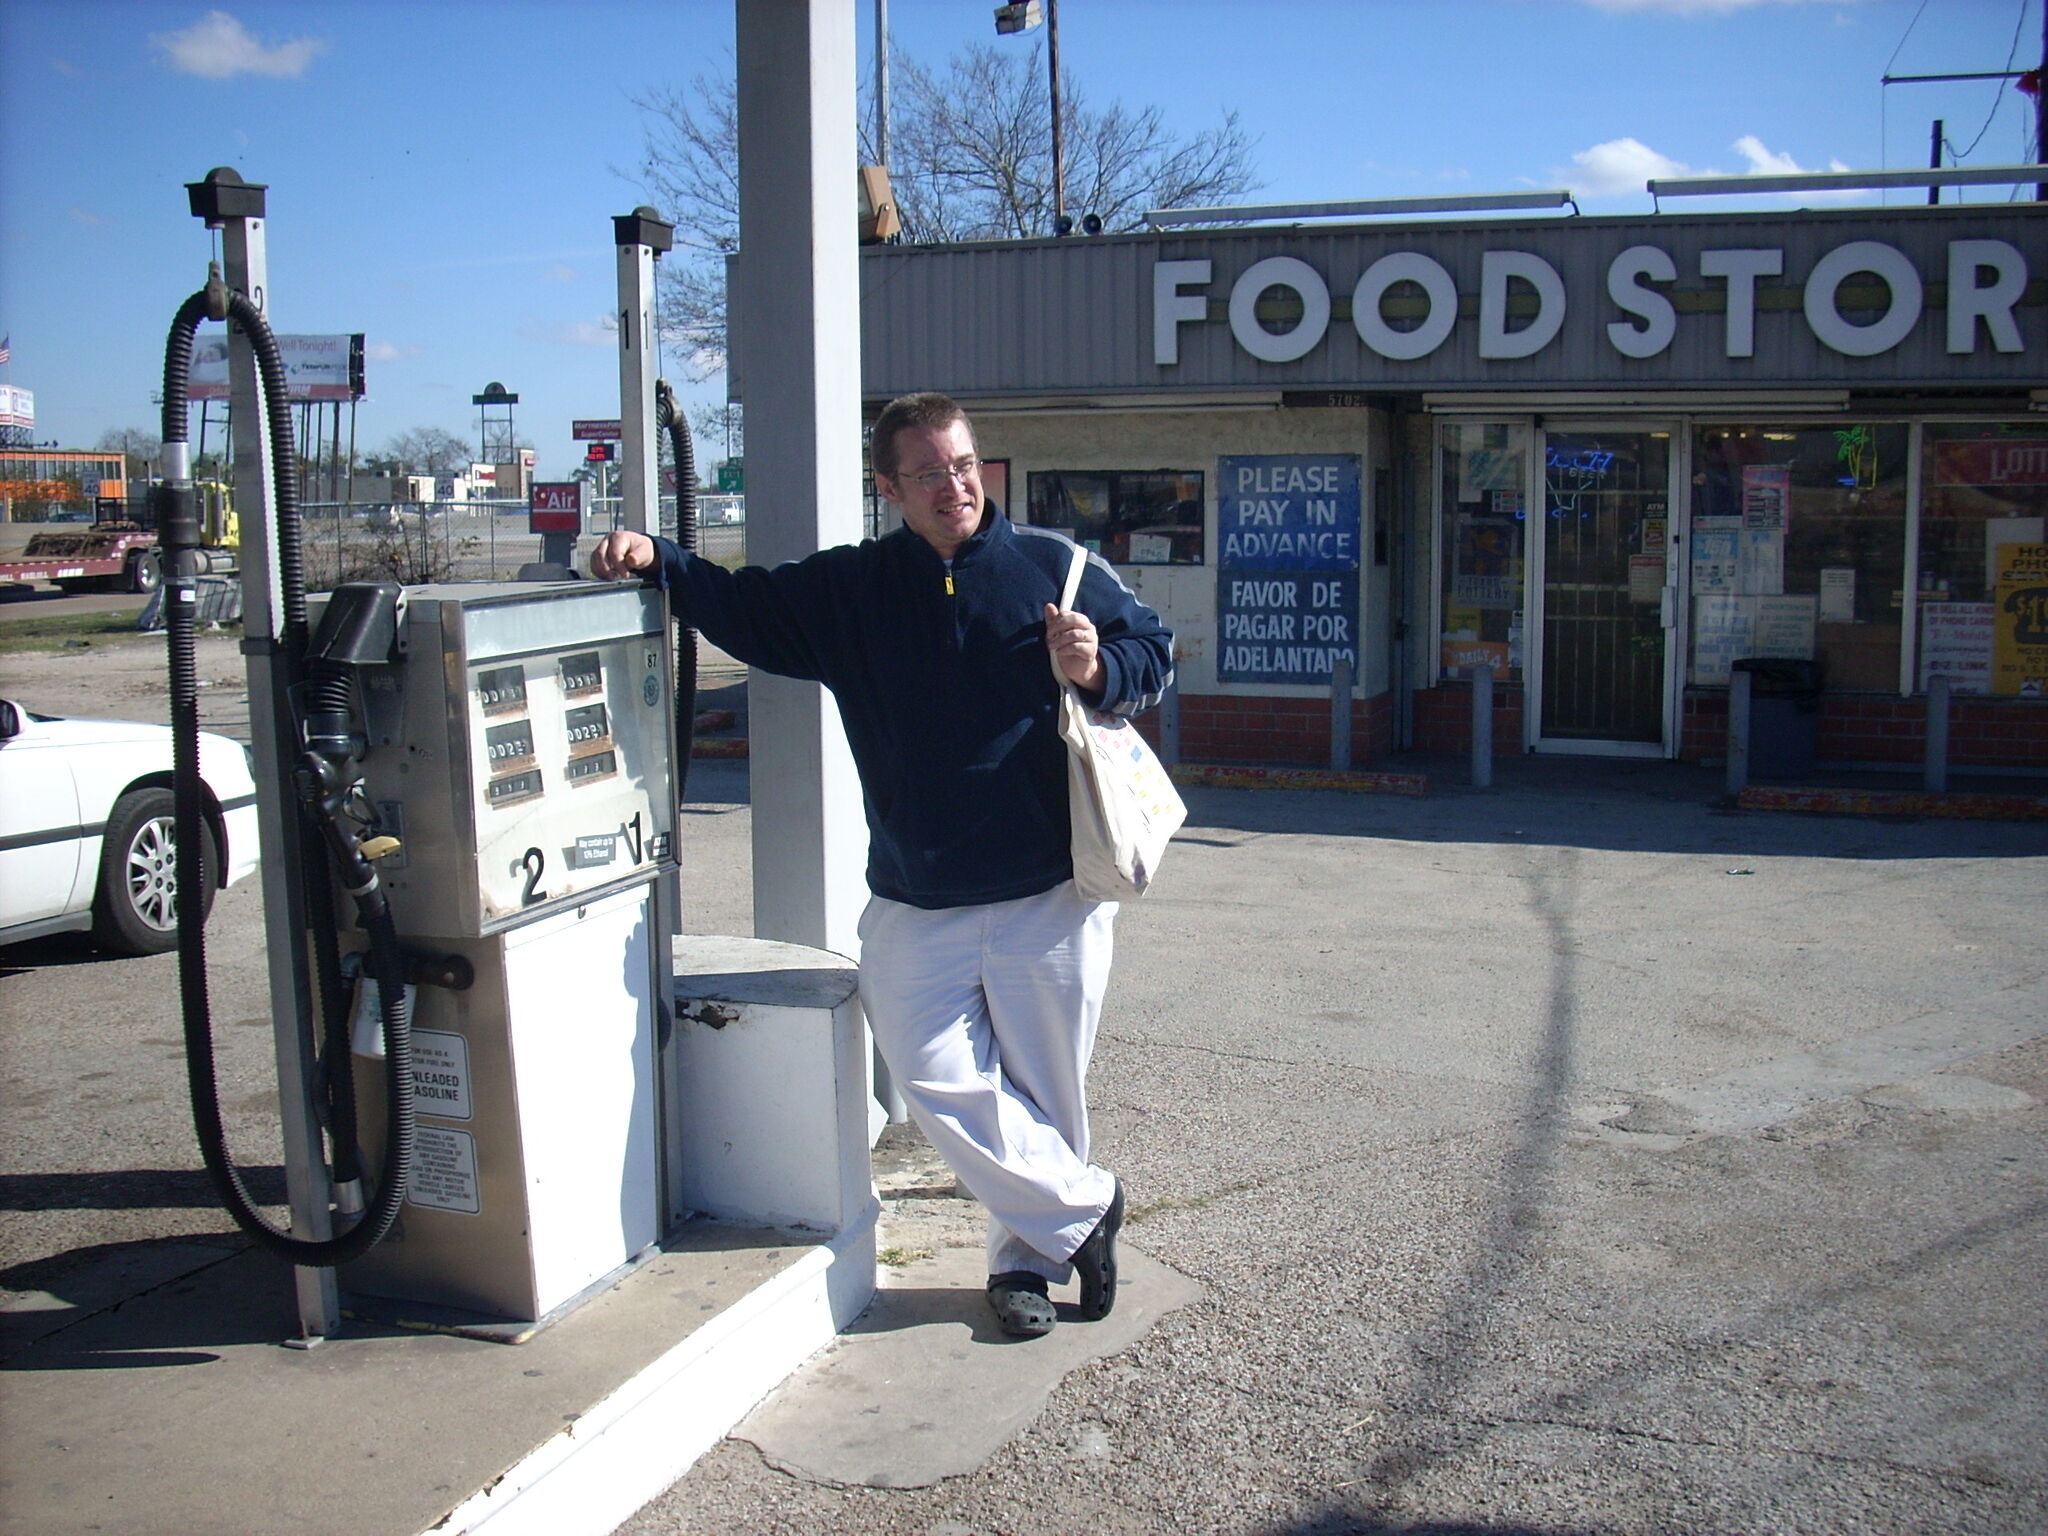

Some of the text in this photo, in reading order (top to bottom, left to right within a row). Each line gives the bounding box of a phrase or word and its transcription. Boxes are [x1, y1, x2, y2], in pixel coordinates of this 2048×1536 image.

[1154, 239, 2027, 364] FOOD STOR
[621, 309, 629, 350] 1
[437, 485, 453, 495] 40
[1238, 466, 1339, 493] PLEASE
[547, 491, 575, 509] Air
[1239, 500, 1336, 526] PAY IN
[1224, 532, 1351, 560] ADVANCE
[1232, 581, 1341, 608] FAVOR DE
[1225, 614, 1349, 641] PAGAR POR
[647, 653, 657, 668] 87
[629, 811, 642, 865] 1
[522, 847, 548, 904] 2
[411, 1071, 459, 1088] NLEADED
[414, 1086, 459, 1102] ASOLINE
